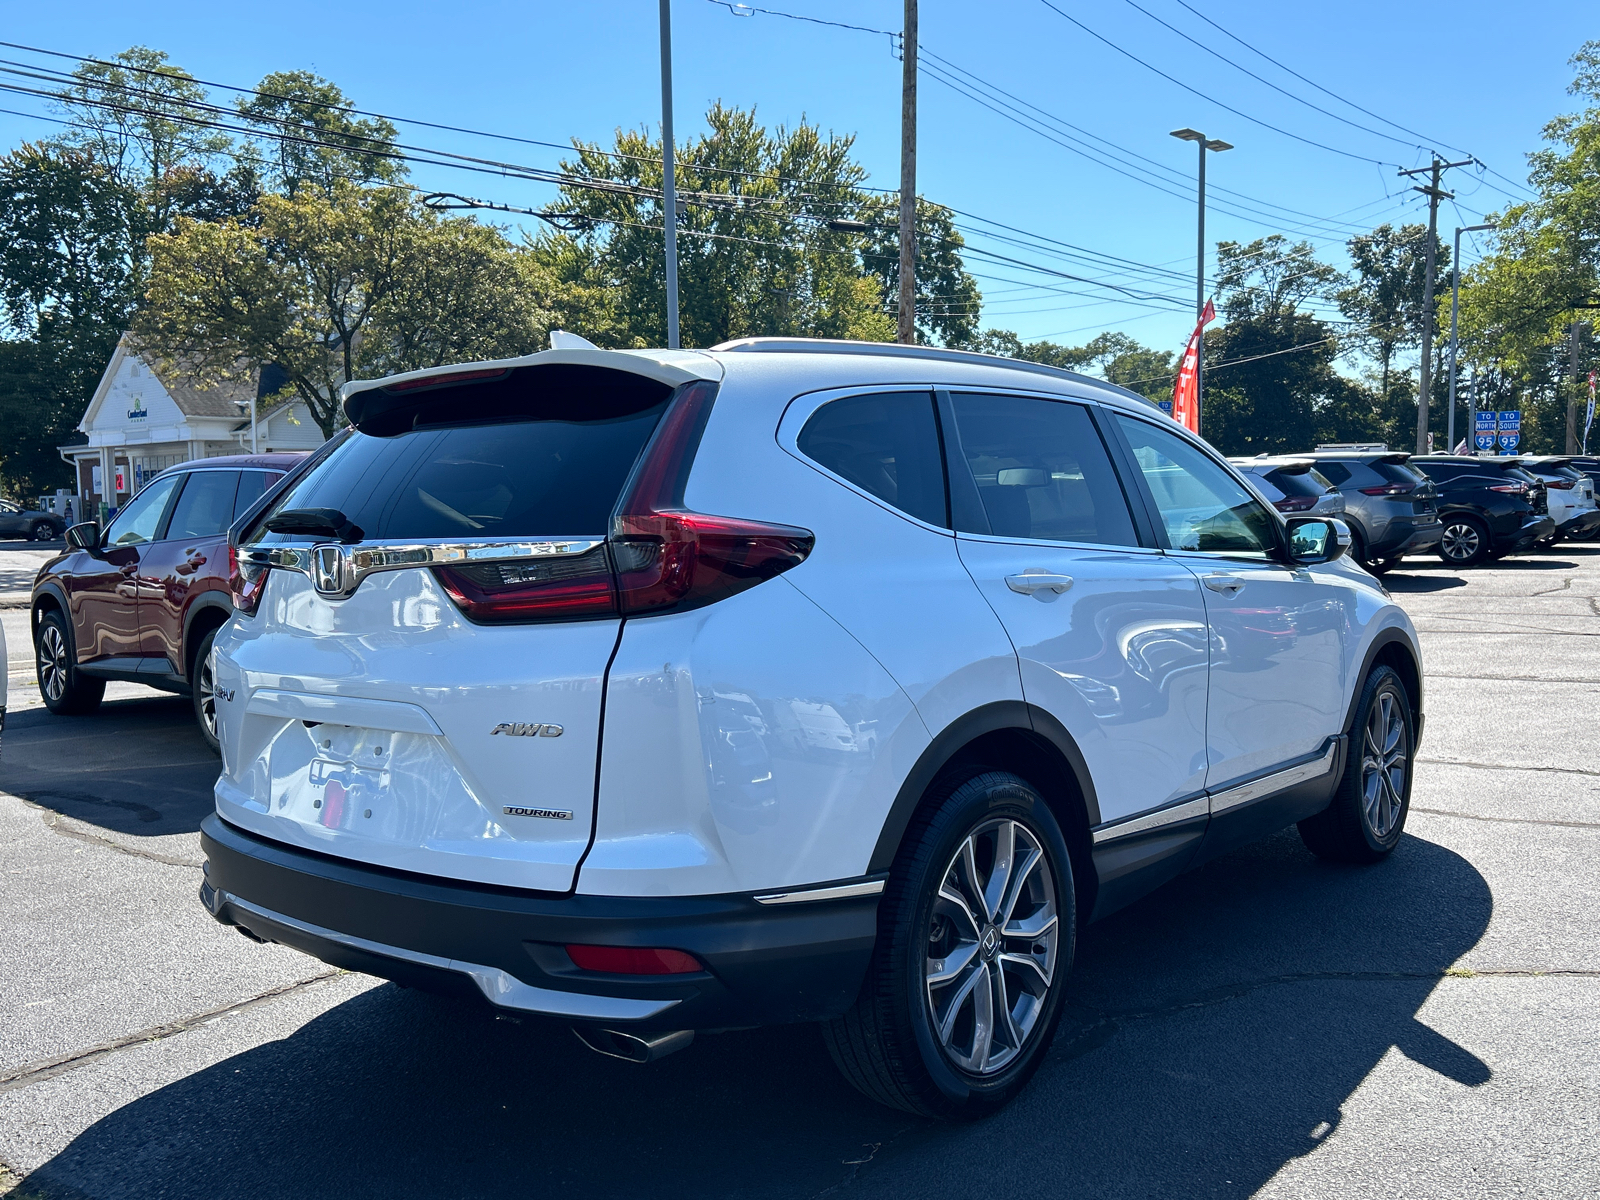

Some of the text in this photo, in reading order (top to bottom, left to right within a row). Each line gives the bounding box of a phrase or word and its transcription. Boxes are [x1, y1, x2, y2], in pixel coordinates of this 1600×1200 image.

[1478, 438, 1492, 446] 95
[1501, 438, 1516, 446] 95
[490, 722, 564, 738] AWD
[506, 806, 567, 819] TOURING
